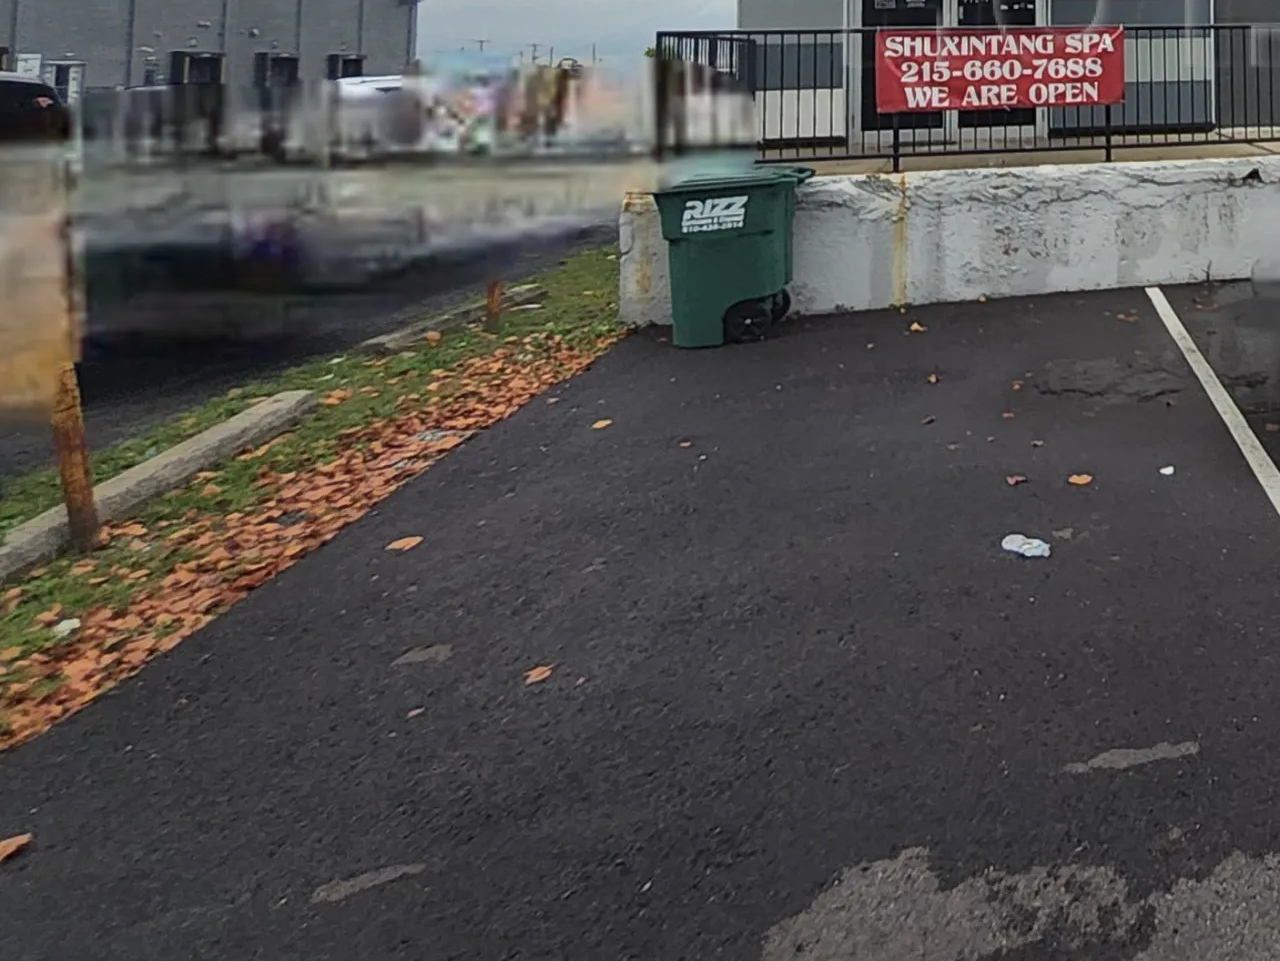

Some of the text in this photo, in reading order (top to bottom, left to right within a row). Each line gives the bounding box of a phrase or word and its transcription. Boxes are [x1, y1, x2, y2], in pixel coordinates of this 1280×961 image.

[884, 33, 1114, 58] SHUXINTANG SPA
[900, 57, 1103, 83] 215-660-7688
[904, 81, 1099, 108] WE ARE OPEN
[684, 196, 748, 220] RIZZ
